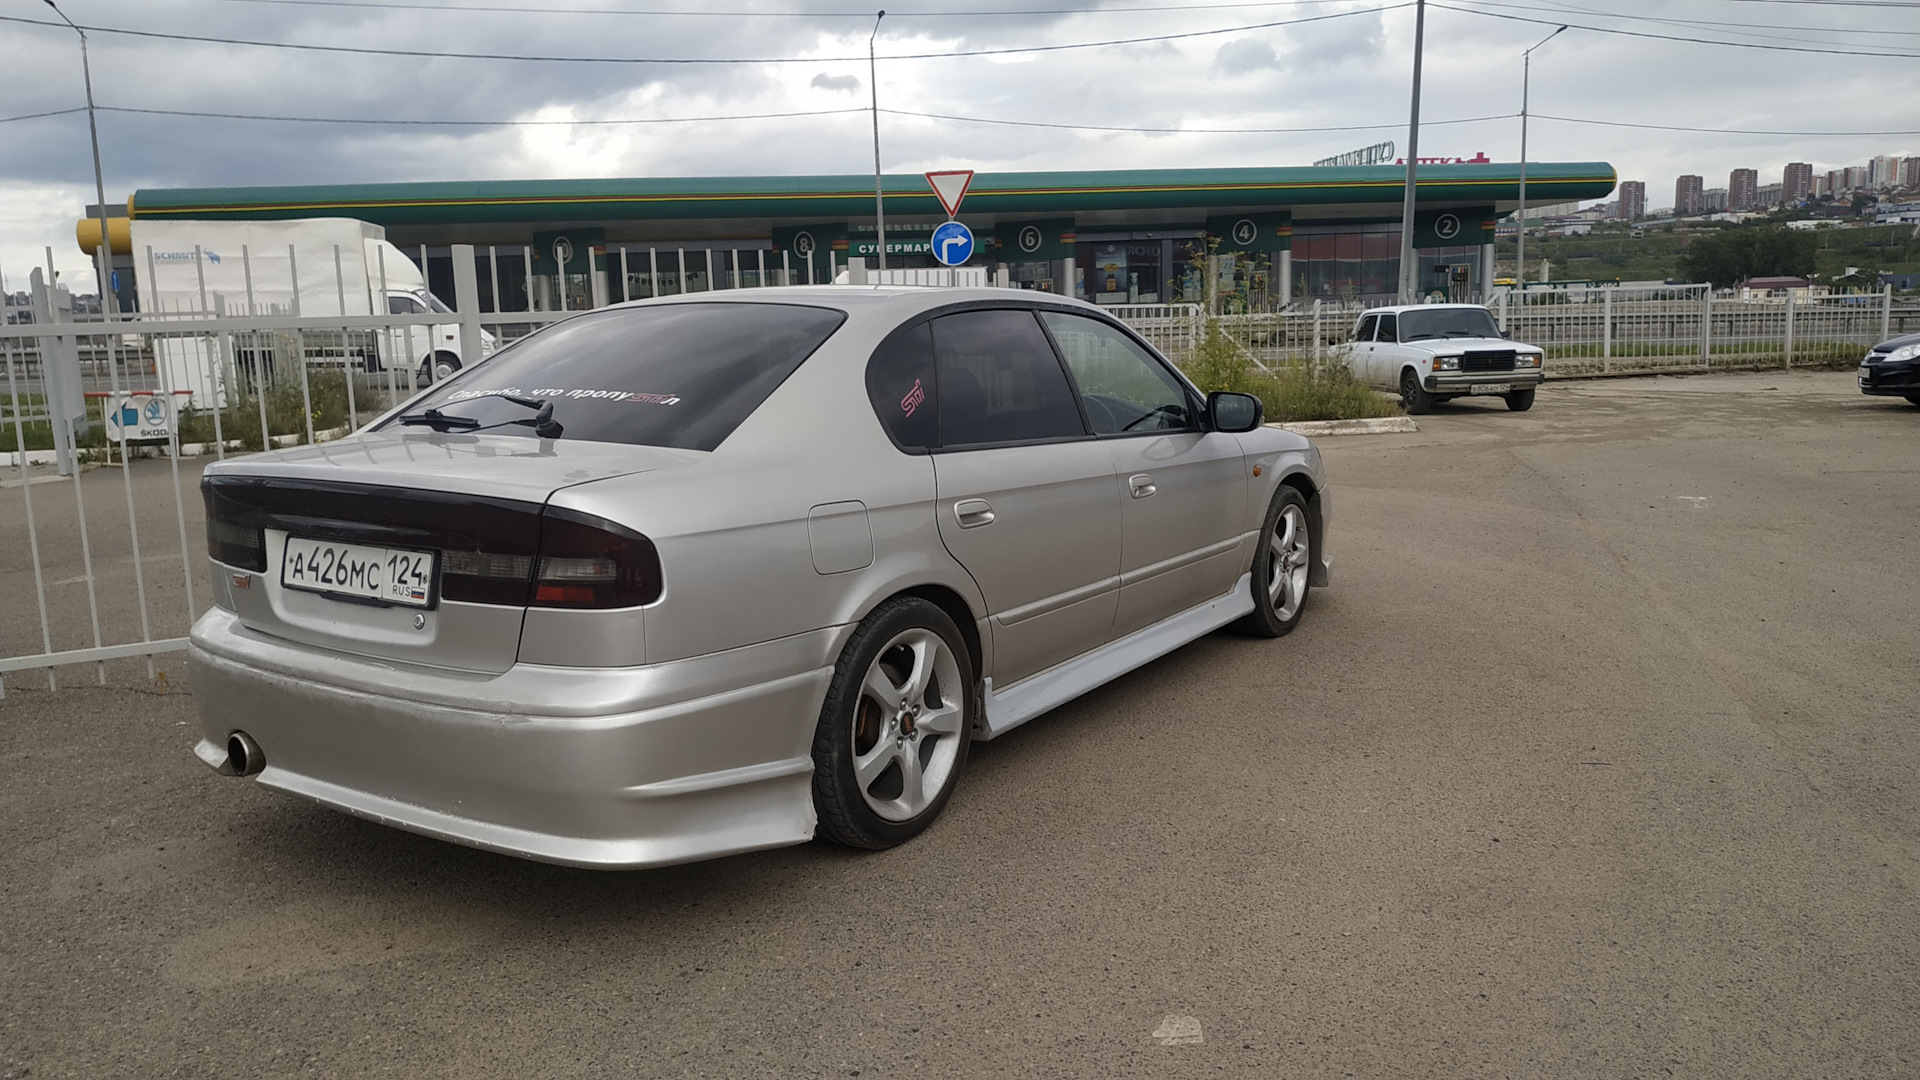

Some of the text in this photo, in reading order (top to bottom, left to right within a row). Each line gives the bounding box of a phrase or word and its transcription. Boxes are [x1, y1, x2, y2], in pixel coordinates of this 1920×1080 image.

[1239, 225, 1250, 239] 4
[1442, 219, 1452, 233] 2
[800, 237, 809, 252] 8
[1025, 232, 1035, 246] 6
[154, 252, 198, 260] SCHMIT
[531, 388, 565, 397] что
[387, 554, 423, 587] 124
[392, 584, 411, 597] RUS
